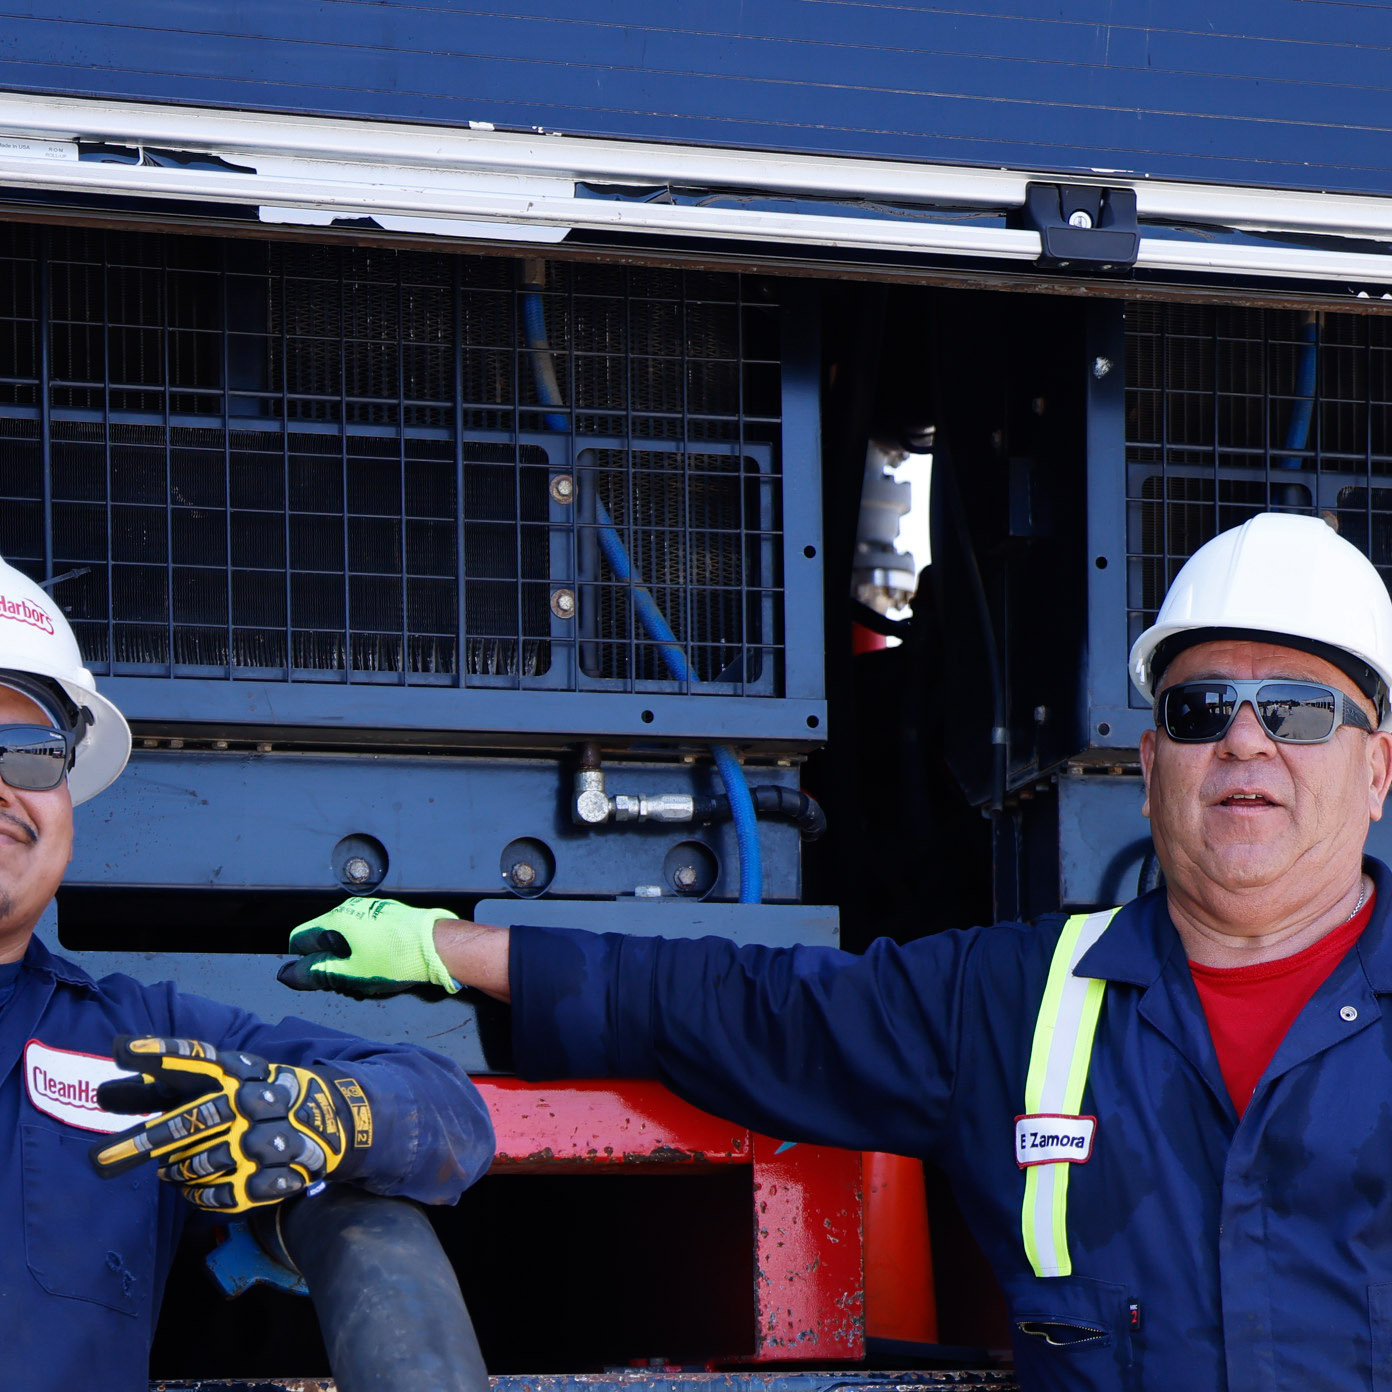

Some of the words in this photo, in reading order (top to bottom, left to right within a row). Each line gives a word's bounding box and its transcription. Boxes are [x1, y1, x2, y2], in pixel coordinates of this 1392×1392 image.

[33, 1066, 98, 1105] CleanHa
[1020, 1133, 1026, 1150] E
[1030, 1132, 1085, 1148] Zamora
[1132, 1310, 1137, 1323] 2
